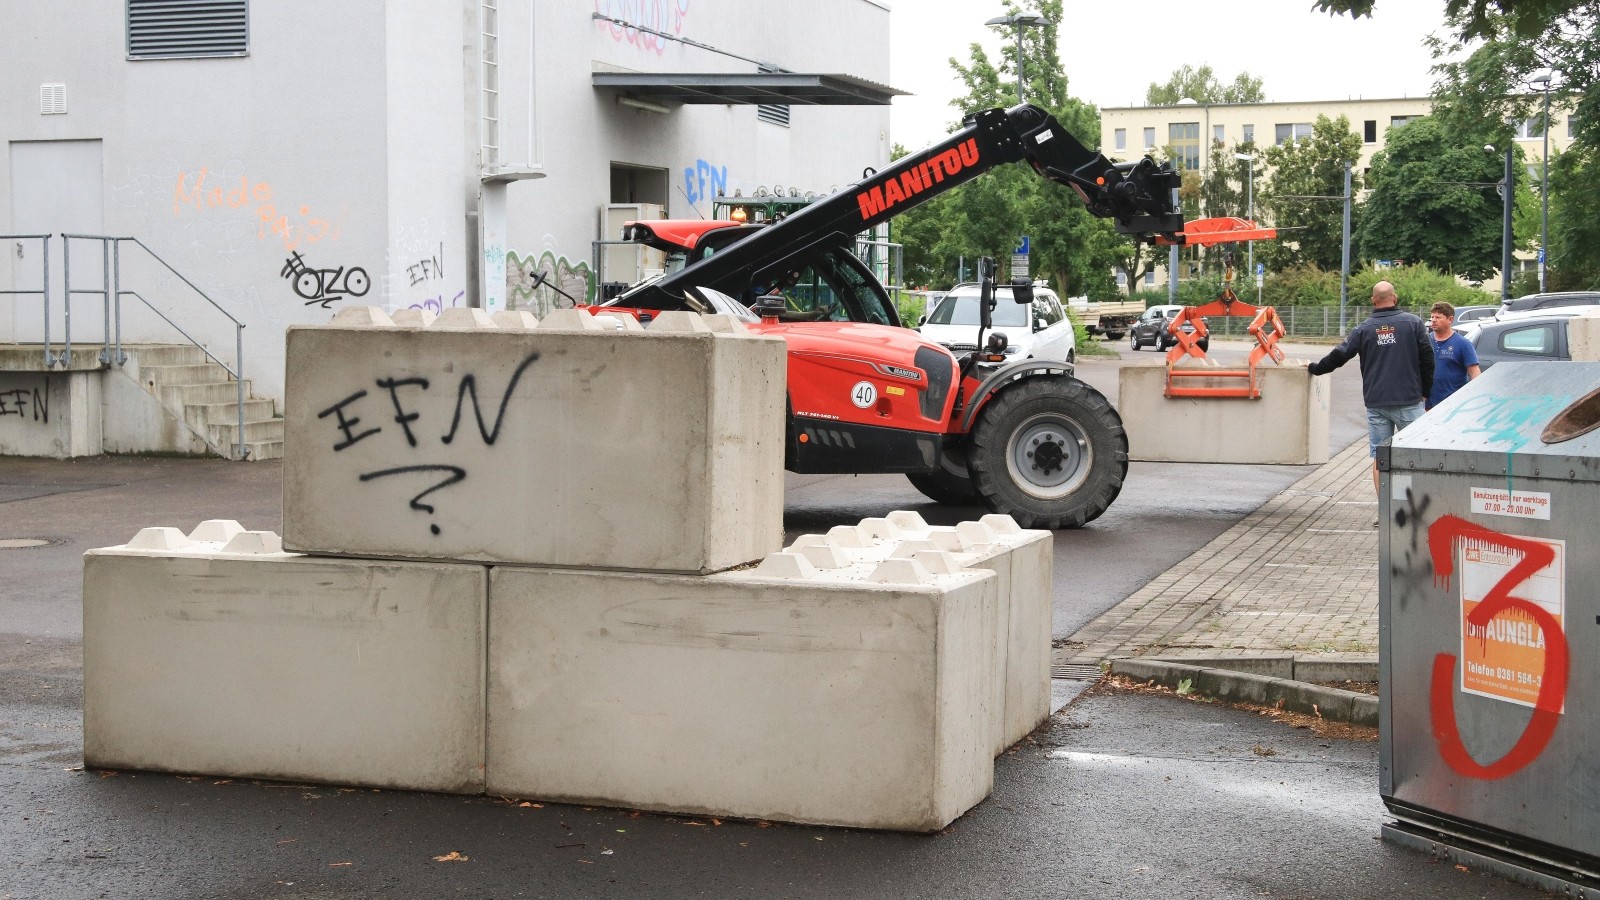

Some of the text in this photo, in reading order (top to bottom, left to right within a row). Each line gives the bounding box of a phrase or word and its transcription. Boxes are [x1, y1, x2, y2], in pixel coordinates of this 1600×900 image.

[173, 165, 273, 216] Made
[684, 158, 728, 204] EFN
[856, 137, 980, 221] MANITOU
[406, 241, 444, 287] EFN
[855, 386, 872, 404] 40
[893, 368, 919, 379] MANITOU
[0, 376, 50, 424] EFN
[318, 351, 541, 451] EFN
[359, 464, 467, 536] ?
[1473, 491, 1499, 502] Benutzung
[1523, 496, 1548, 507] werktags
[1524, 506, 1536, 515] Uhr
[1466, 616, 1546, 649] AUNGLA
[1467, 661, 1542, 687] Telefon 0361 564-3
